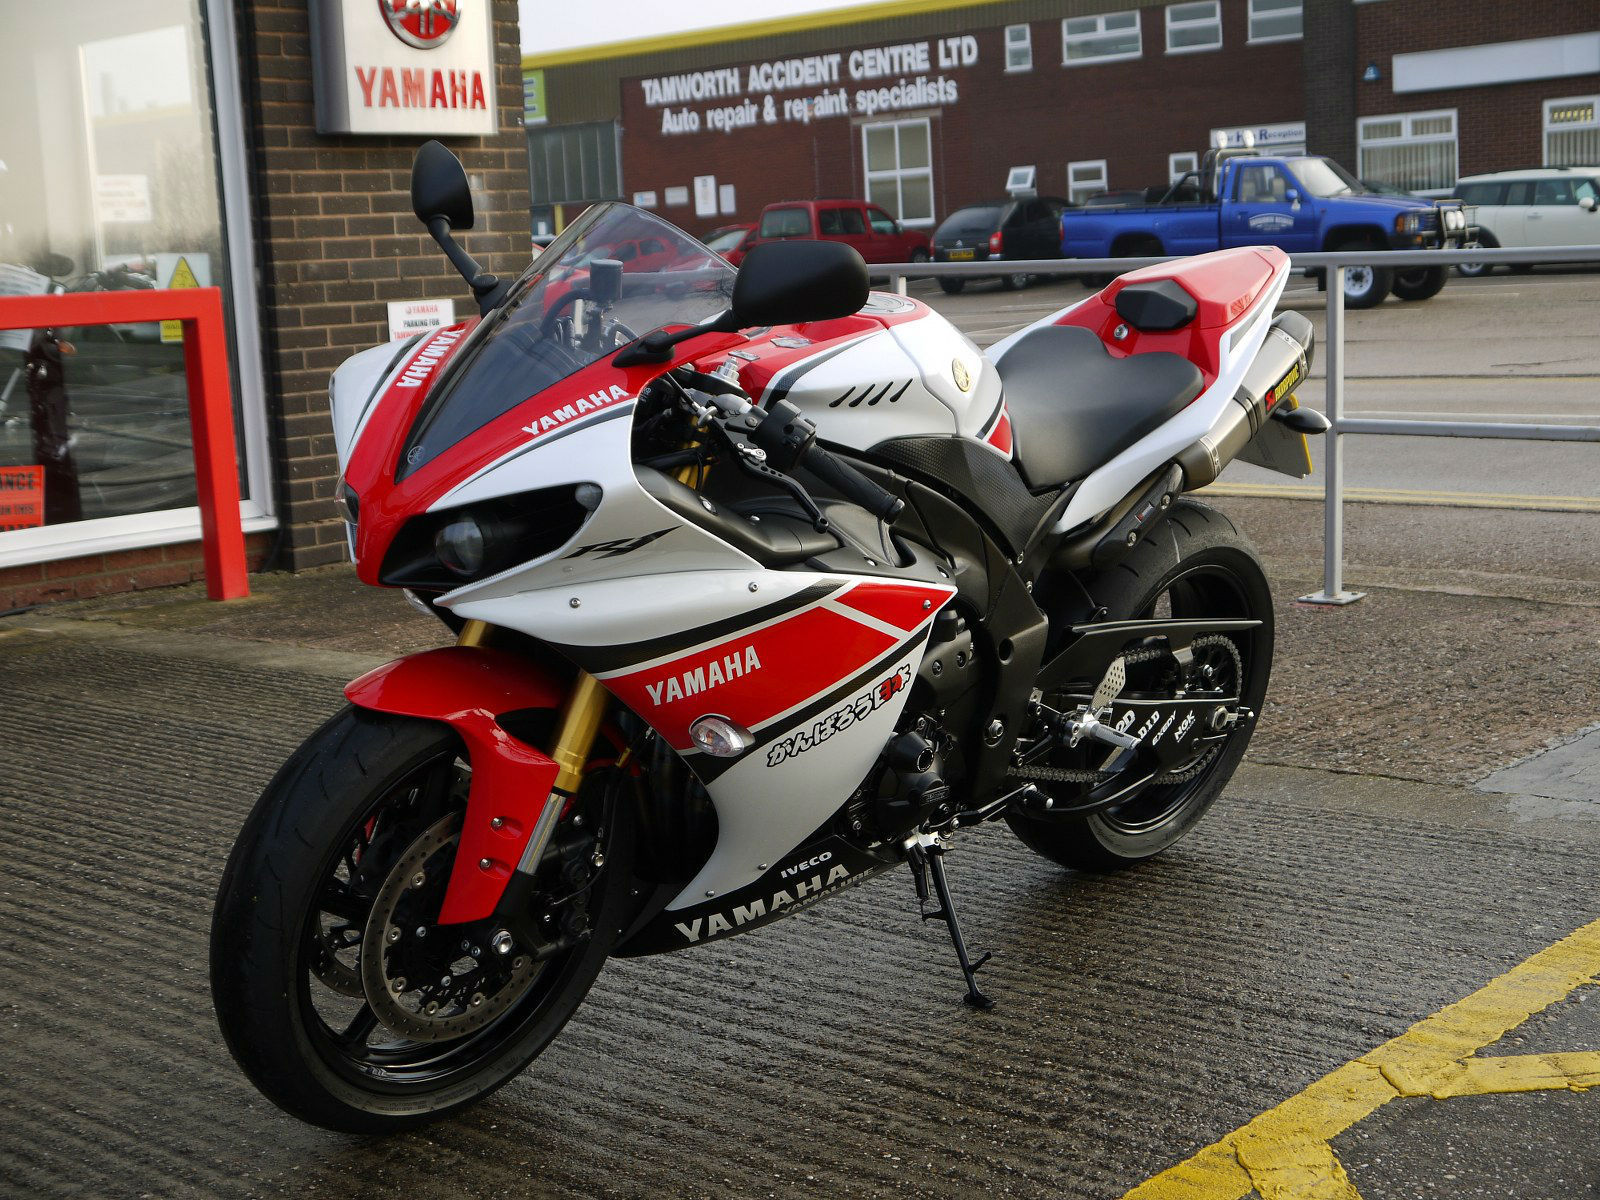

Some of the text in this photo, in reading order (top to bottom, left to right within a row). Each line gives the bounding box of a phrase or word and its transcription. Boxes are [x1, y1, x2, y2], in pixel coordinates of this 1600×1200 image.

[354, 66, 487, 109] YAMAHA
[642, 35, 978, 105] TAMWORTH ACCIDENT CENTRE LTD
[662, 107, 699, 133] Auto
[706, 98, 758, 132] repair
[763, 95, 777, 122] &
[856, 75, 958, 115] specialists
[403, 320, 428, 328] PARKING
[412, 304, 438, 314] YAMAHA
[396, 328, 466, 387] YAMAHA
[521, 384, 629, 436] YAMAHA
[645, 645, 762, 706] YAMAHA
[1174, 709, 1196, 741] NGK
[780, 851, 833, 879] IVECO
[674, 863, 850, 943] YAMAHA
